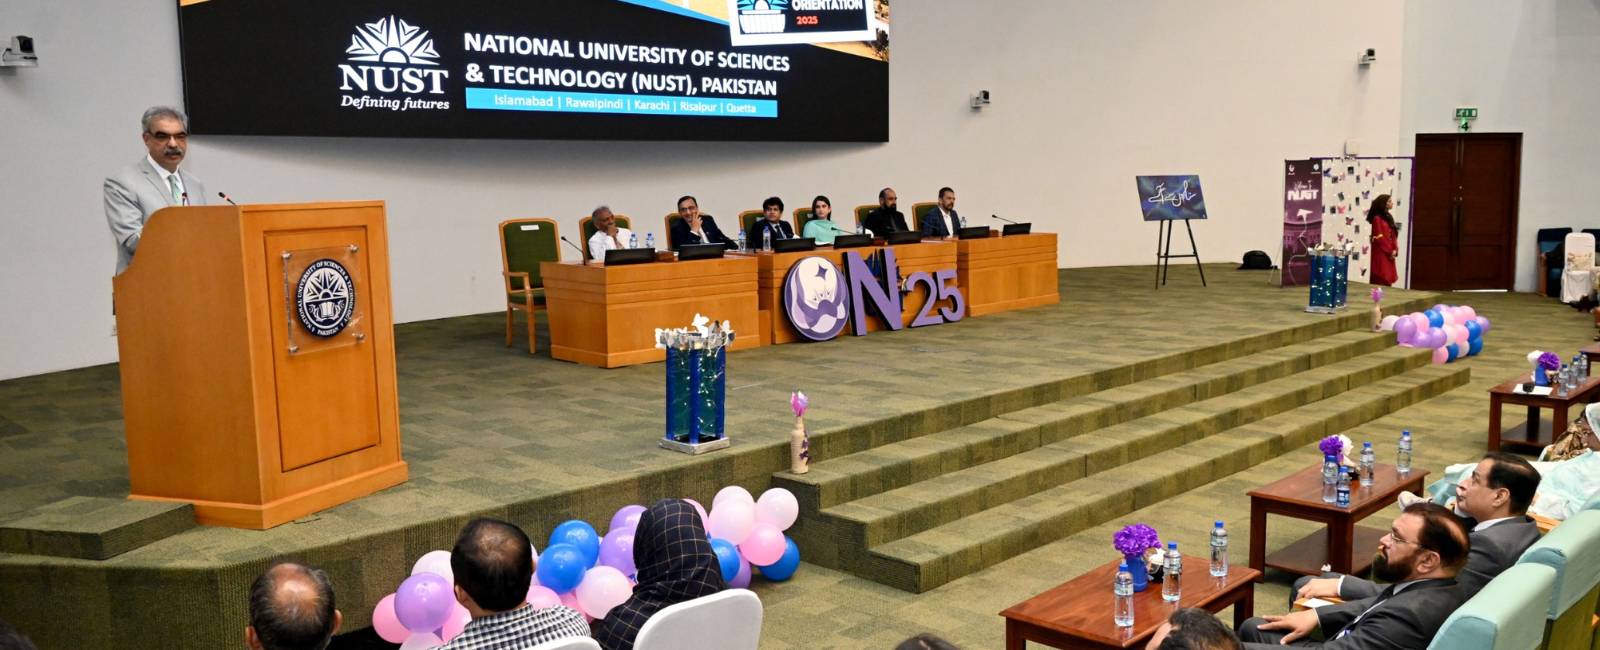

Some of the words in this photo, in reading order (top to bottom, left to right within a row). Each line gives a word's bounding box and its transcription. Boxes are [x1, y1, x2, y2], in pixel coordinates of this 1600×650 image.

[791, 0, 864, 11] ORIENTATION
[796, 15, 819, 25] 2025
[464, 32, 575, 58] NATIONAL
[578, 41, 687, 65] UNIVERSITY
[690, 49, 714, 67] OF
[717, 51, 790, 72] SCIENCES
[338, 64, 449, 94] NUST
[465, 63, 485, 83] &
[489, 64, 627, 89] TECHNOLOGY
[631, 71, 698, 95] (NUST),
[701, 76, 777, 96] PAKISTAN
[340, 94, 401, 111] Defining
[401, 96, 450, 111] futures
[494, 94, 554, 107] Islamabad
[565, 97, 624, 110] Rawalpindi
[634, 100, 670, 111] Karachi
[680, 101, 717, 113] Risalpur
[726, 103, 757, 113] Quetta
[323, 261, 346, 276] SCIENCES
[297, 263, 317, 298] UNIVERSITY
[297, 300, 313, 330] NATIONAL
[317, 327, 339, 336] PAKISTAN
